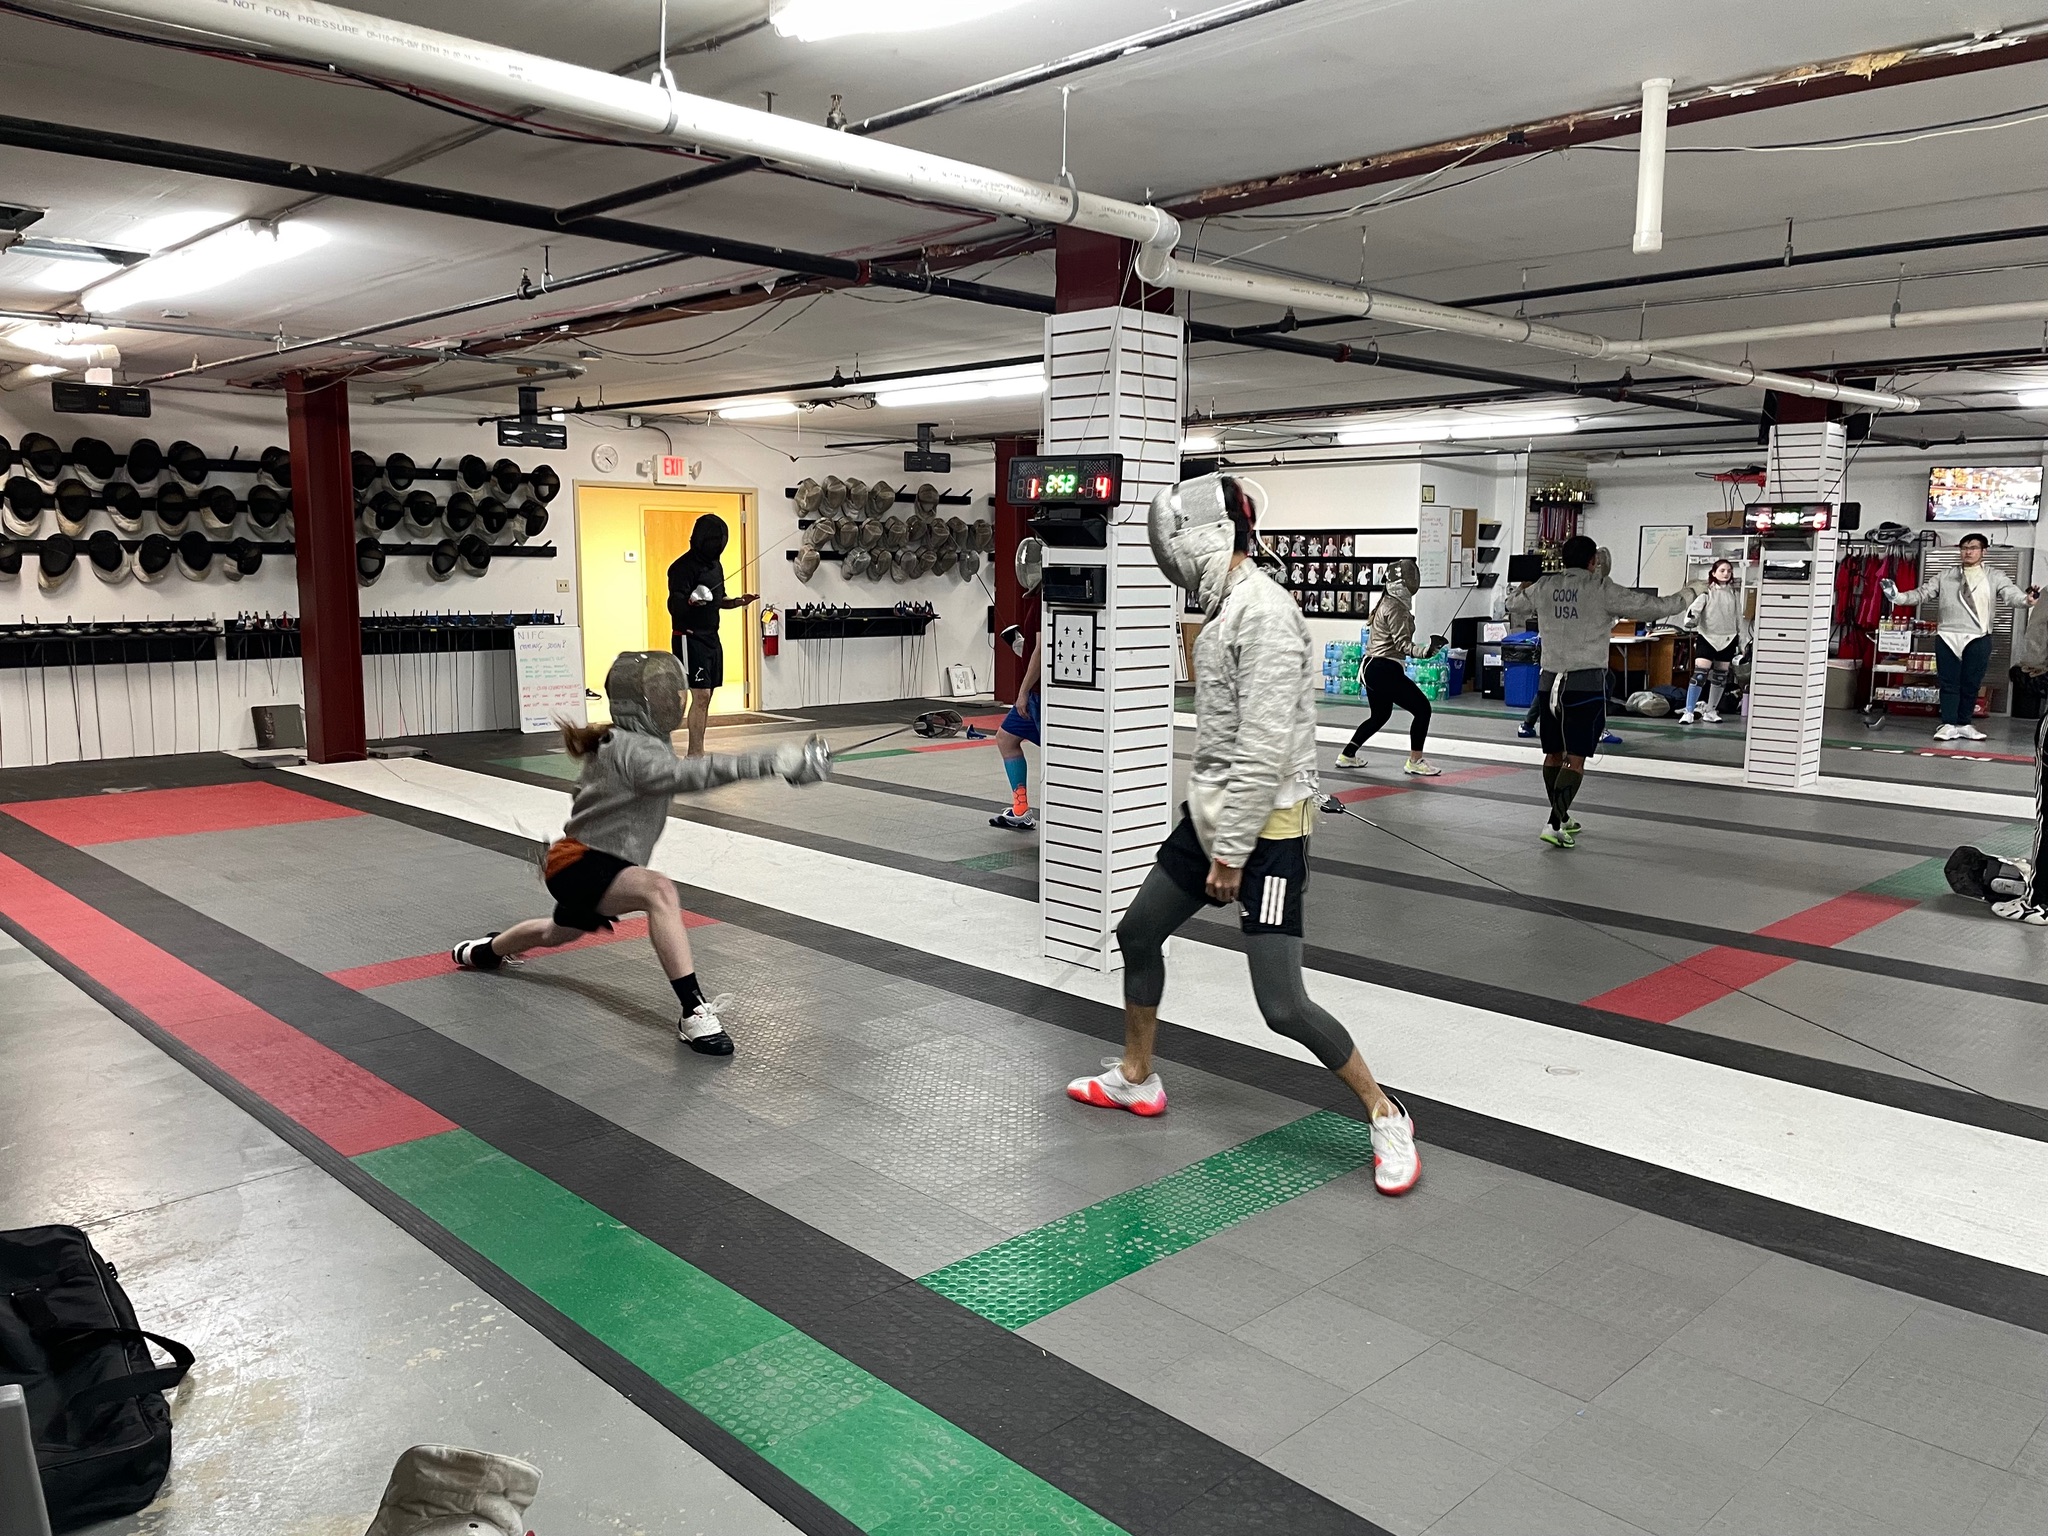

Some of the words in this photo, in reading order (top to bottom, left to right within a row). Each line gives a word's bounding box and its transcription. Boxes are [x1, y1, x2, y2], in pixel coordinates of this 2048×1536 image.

[232, 0, 257, 11] NOT
[265, 6, 290, 20] FOR
[297, 14, 359, 35] PRESSURE
[663, 457, 684, 476] EXIT
[1095, 476, 1109, 499] 4
[1553, 589, 1578, 602] COOK
[1555, 606, 1578, 619] USA
